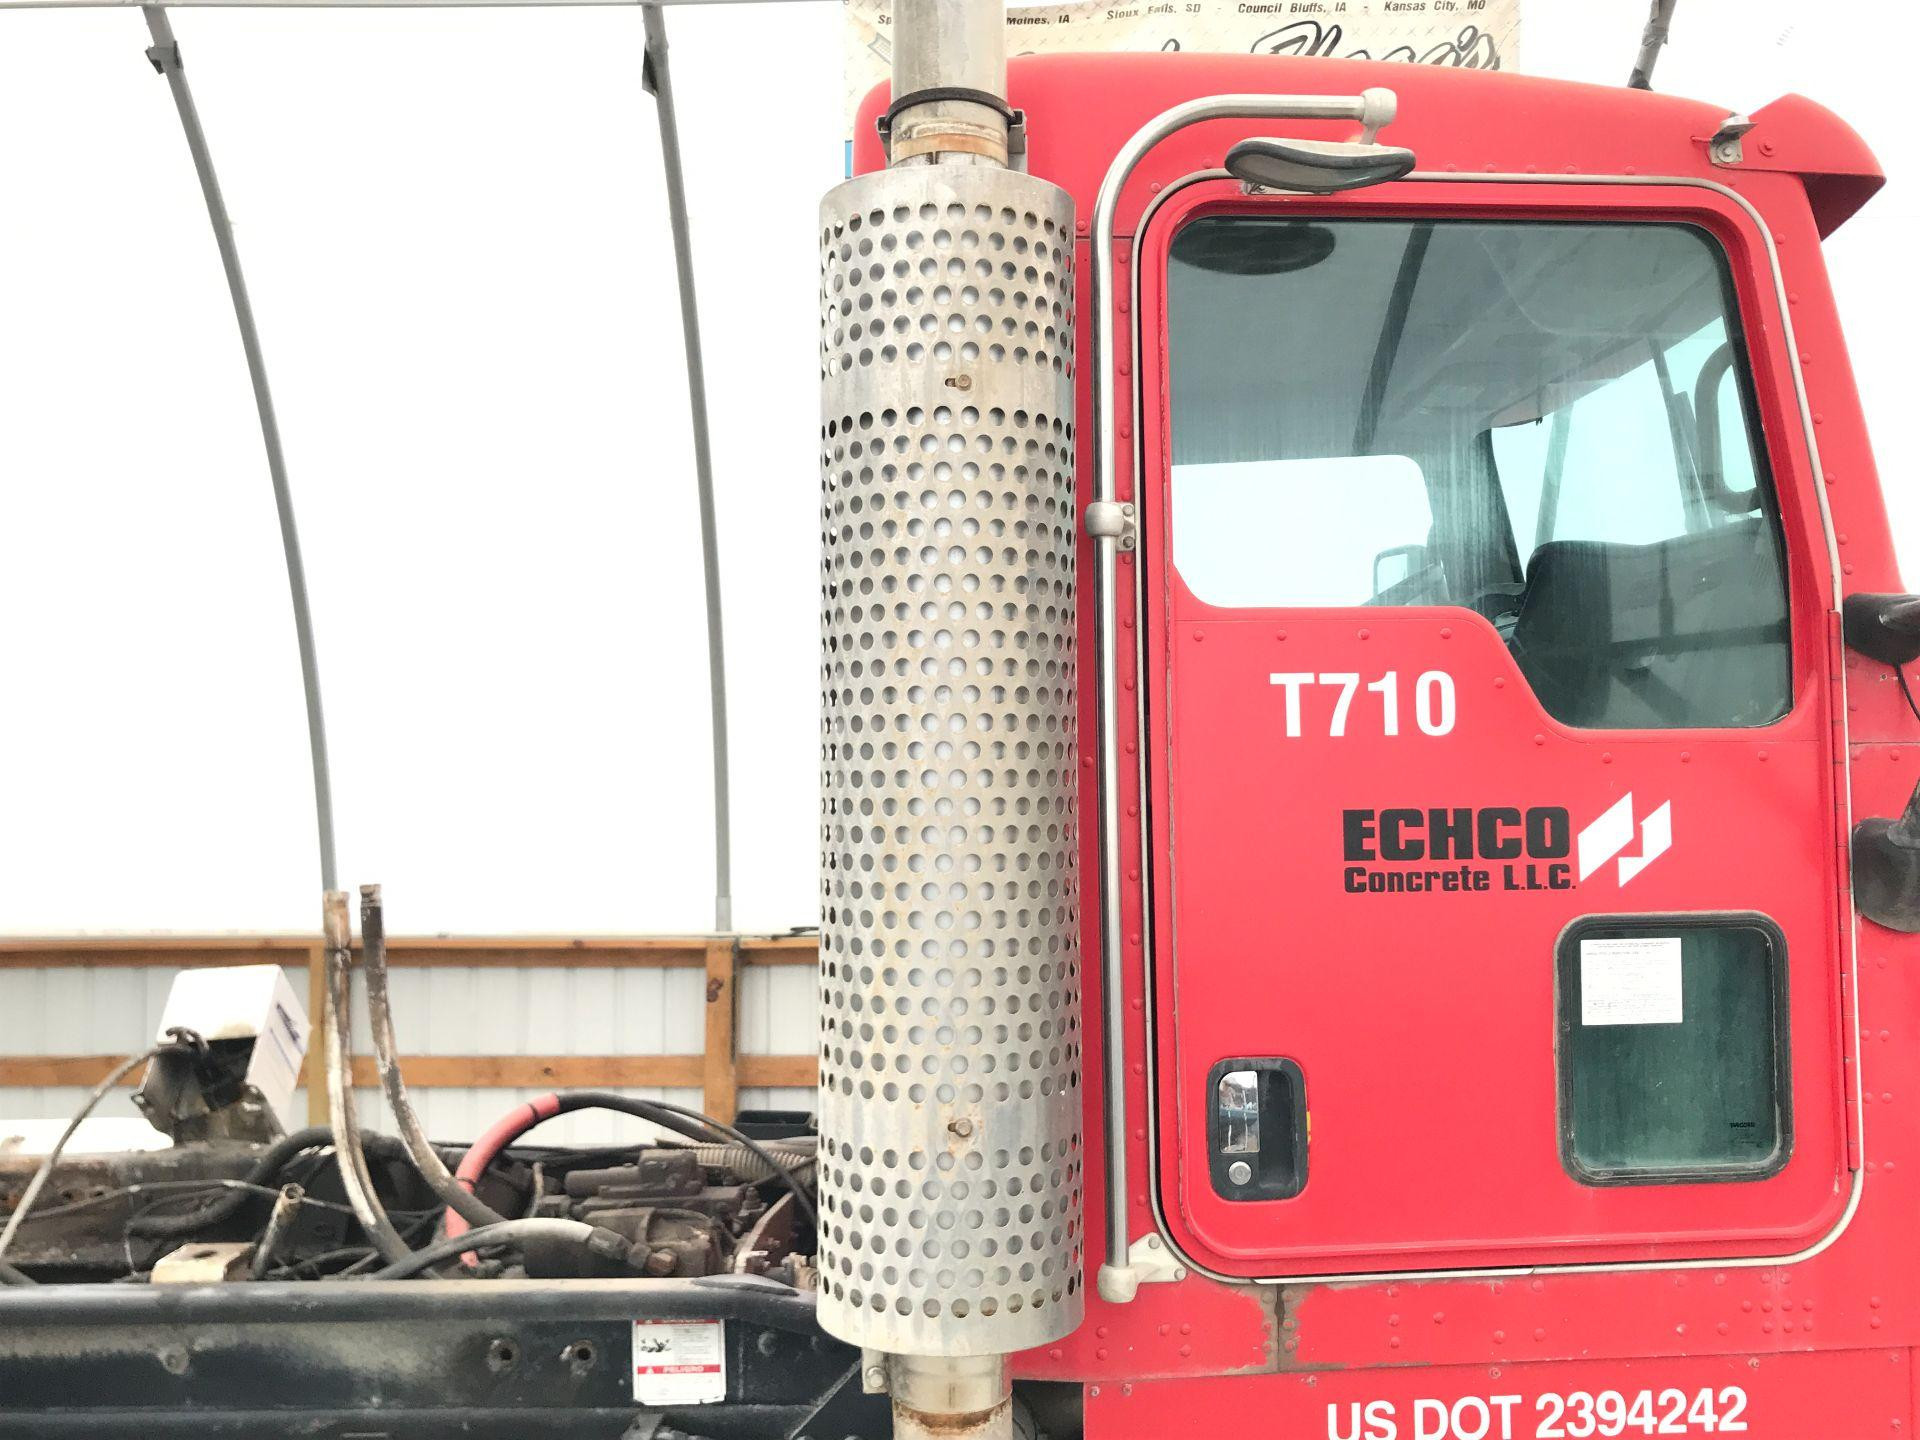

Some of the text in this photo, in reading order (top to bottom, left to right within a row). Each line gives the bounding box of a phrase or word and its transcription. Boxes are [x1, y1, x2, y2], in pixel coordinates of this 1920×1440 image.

[1058, 14, 1071, 24] IA
[1106, 9, 1139, 20] Sioux
[1185, 3, 1202, 13] SD
[1238, 3, 1283, 13] Council
[1289, 2, 1328, 13] Bluffs,
[1335, 2, 1347, 12] IA
[1384, 1, 1427, 11] Kansas
[1433, 0, 1460, 12] City,
[1467, 0, 1487, 10] MO
[1269, 670, 1457, 738] T710
[1342, 806, 1570, 861] ECHCO
[1343, 863, 1577, 893] Concrete L.L.C.
[1327, 1386, 1749, 1440] US DOT 2394242
